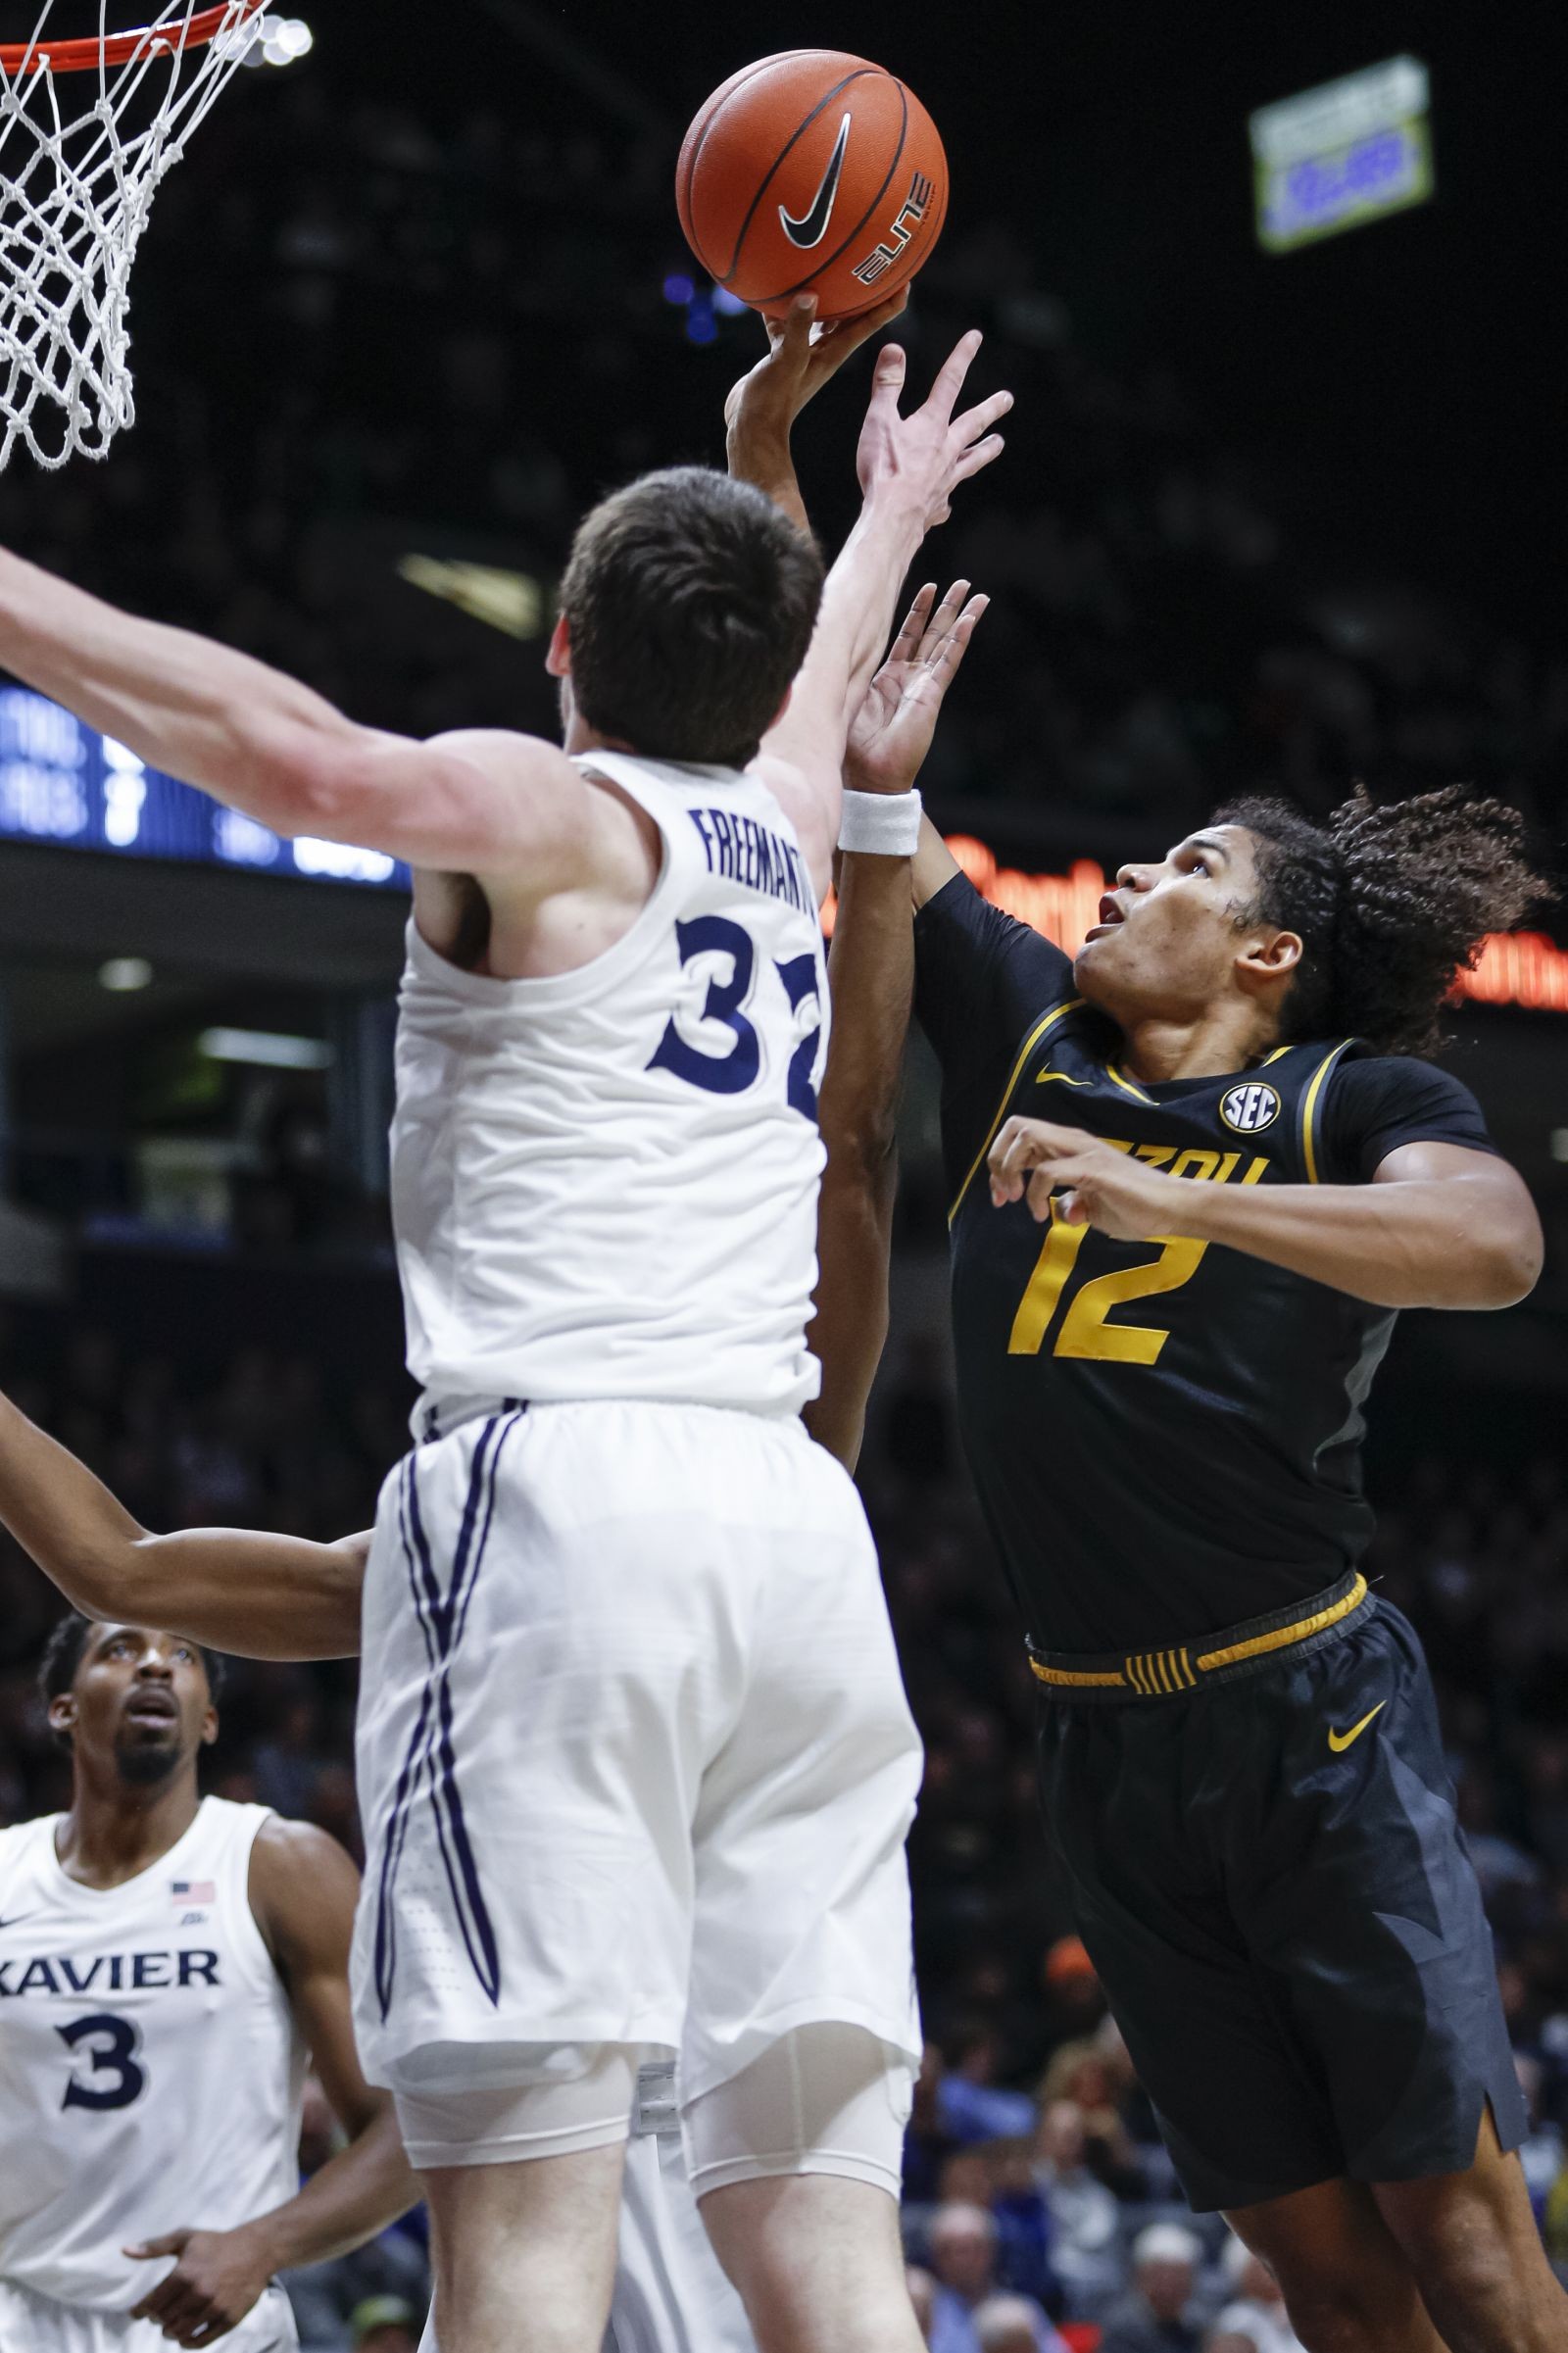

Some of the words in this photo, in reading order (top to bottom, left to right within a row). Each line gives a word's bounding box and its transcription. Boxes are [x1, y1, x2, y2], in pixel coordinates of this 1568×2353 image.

[851, 172, 933, 285] ELITE
[1225, 1084, 1277, 1130] SEC
[1007, 1197, 1210, 1365] 12
[0, 1949, 220, 1996] XAVIER
[54, 2013, 145, 2113] 3
